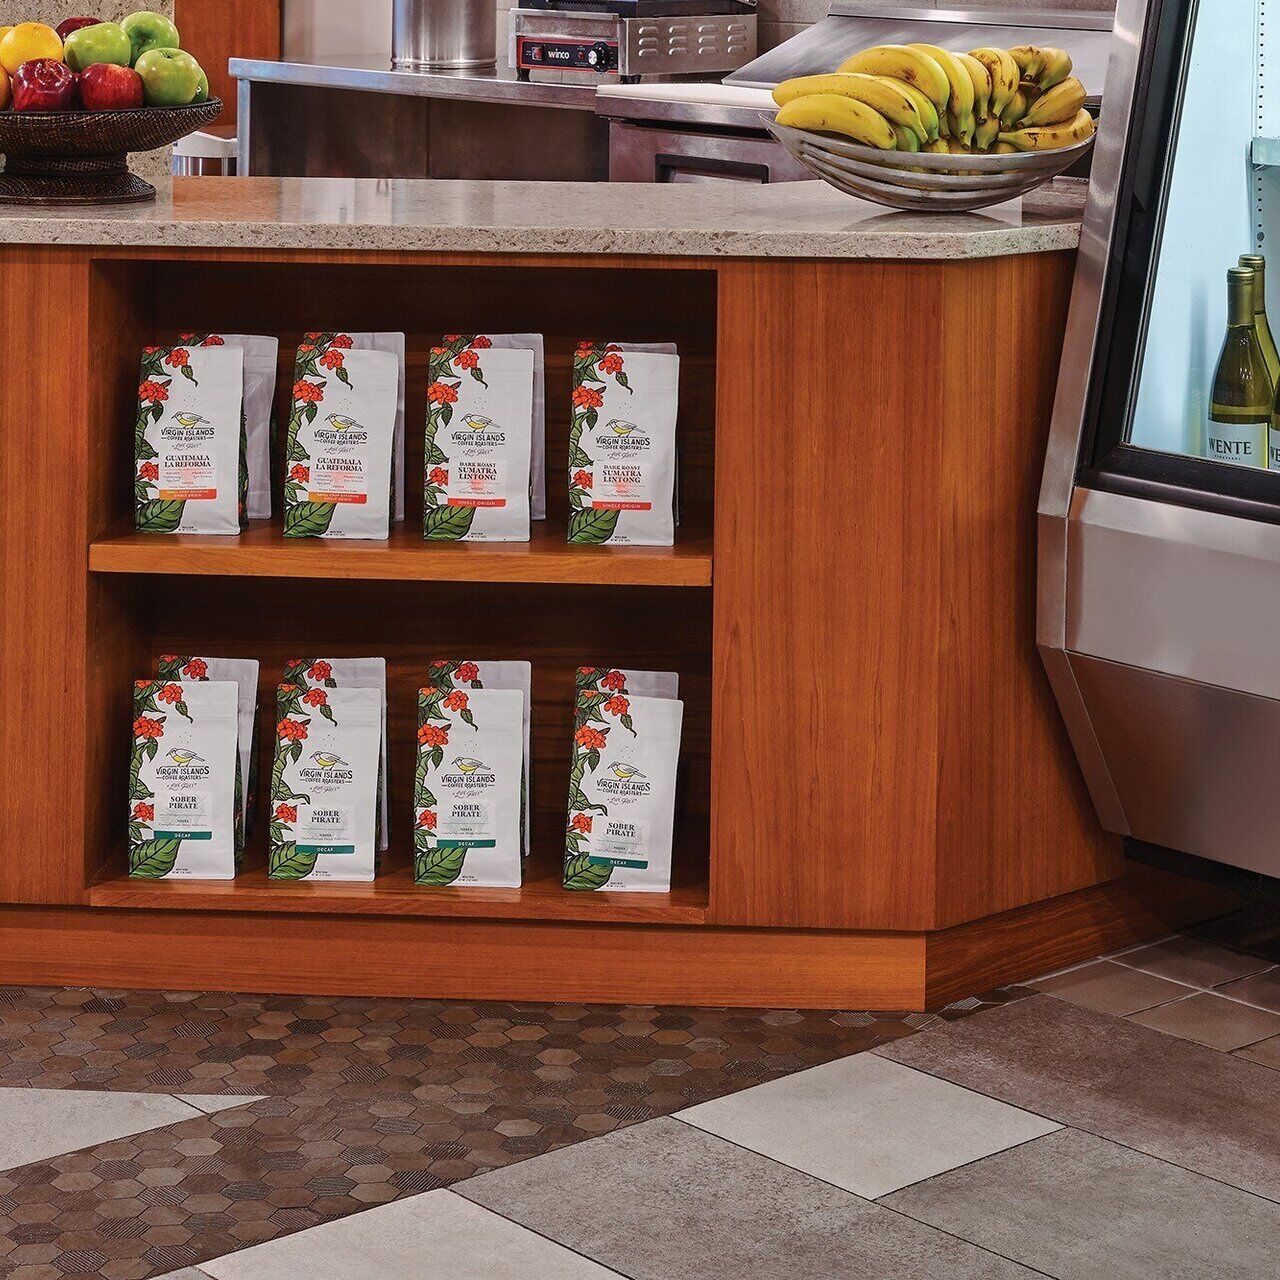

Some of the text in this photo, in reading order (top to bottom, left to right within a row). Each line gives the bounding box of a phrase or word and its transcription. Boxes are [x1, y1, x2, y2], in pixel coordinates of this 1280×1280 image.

[547, 48, 570, 59] winco
[160, 426, 215, 437] VIRGIN ISLANDS
[313, 430, 368, 441] VIRGIN ISLANDS
[451, 431, 505, 441] VIRGIN ISLANDS
[595, 436, 651, 446] VIRGIN ISLANDS
[1208, 437, 1252, 455] WENTE
[317, 458, 362, 466] GUATEMALA
[326, 464, 363, 472] REFORMA
[155, 765, 210, 775] VIRGIN ISLANDS
[299, 768, 353, 779] VIRGIN ISLANDS
[441, 773, 496, 783] VIRGIN ISLANDS
[596, 778, 651, 792] VIRGIN ISLANDS
[607, 822, 635, 831] SOBER
[606, 828, 636, 837] PIRATE
